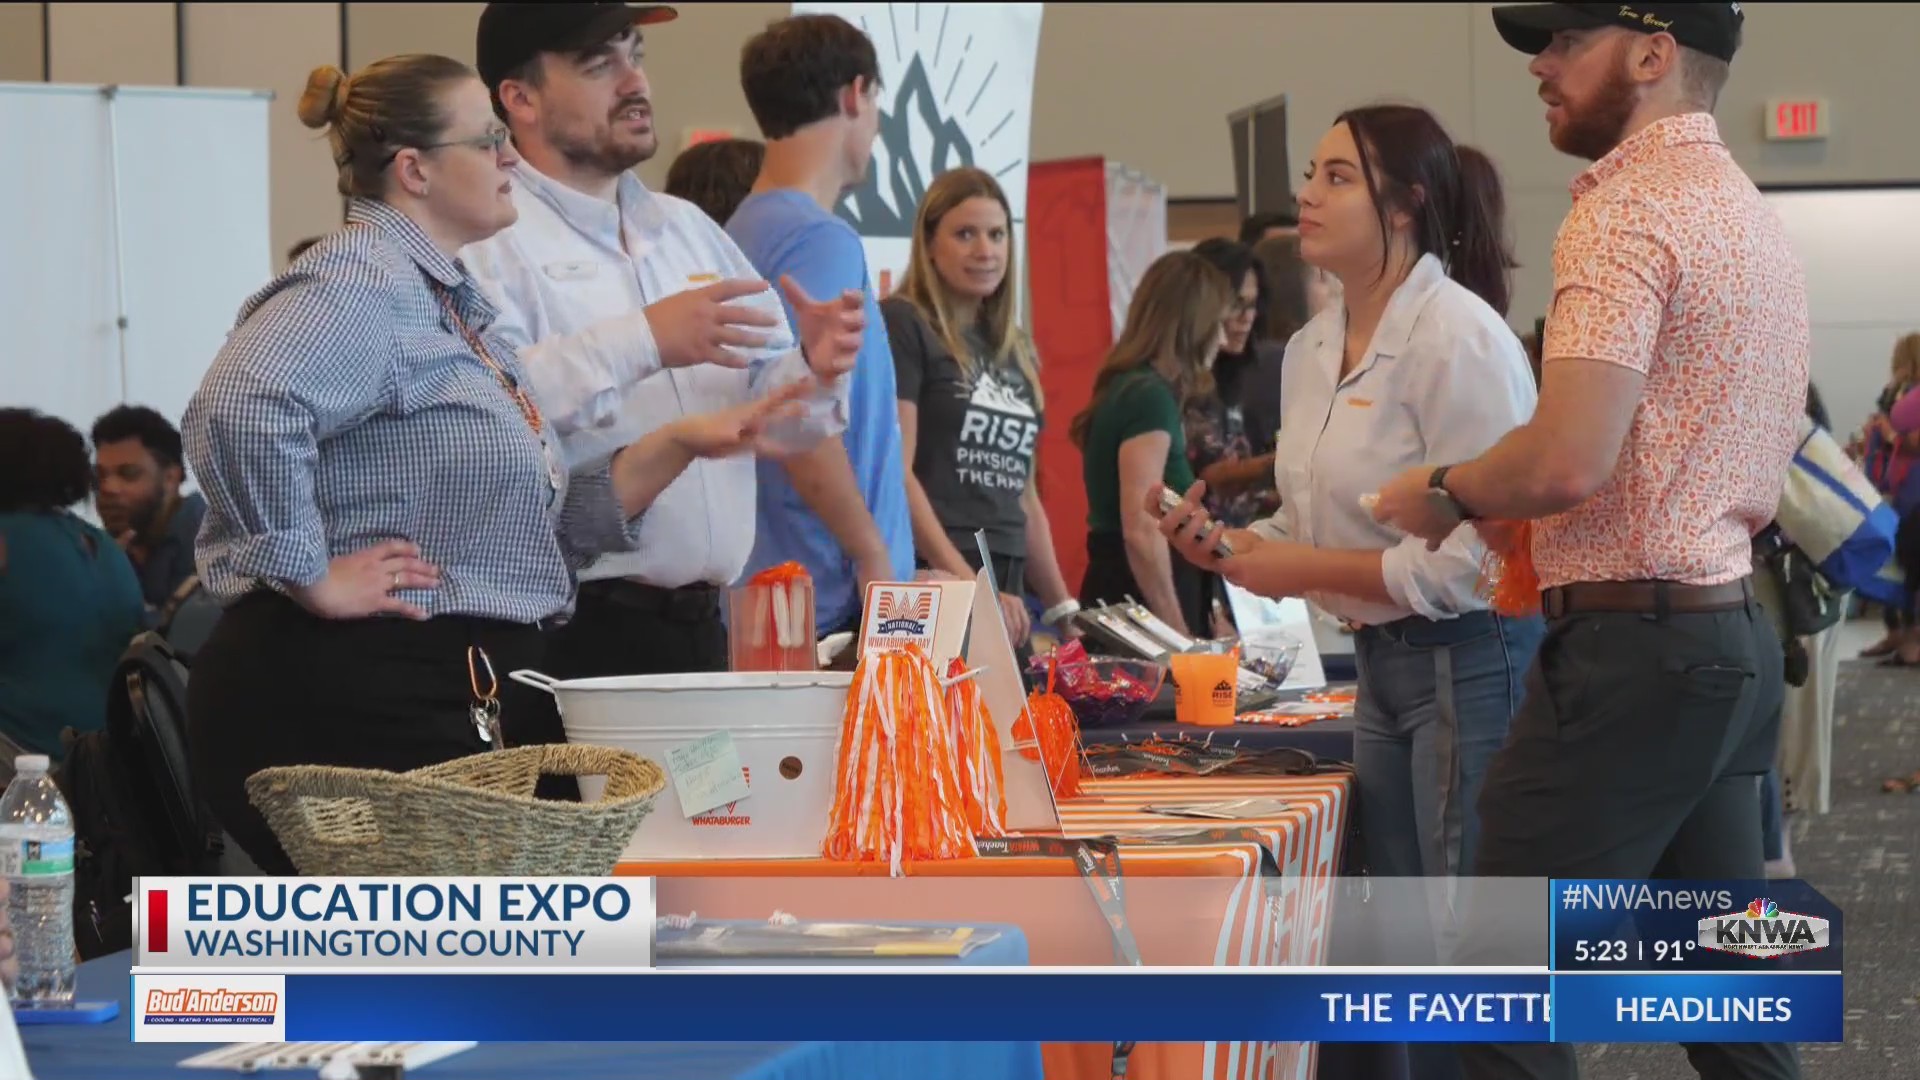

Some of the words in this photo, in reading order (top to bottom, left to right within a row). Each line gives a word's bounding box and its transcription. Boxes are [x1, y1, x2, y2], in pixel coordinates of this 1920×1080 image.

[1776, 102, 1819, 137] EXIT
[960, 409, 1038, 456] RISE
[692, 816, 750, 825] WHATABURGER
